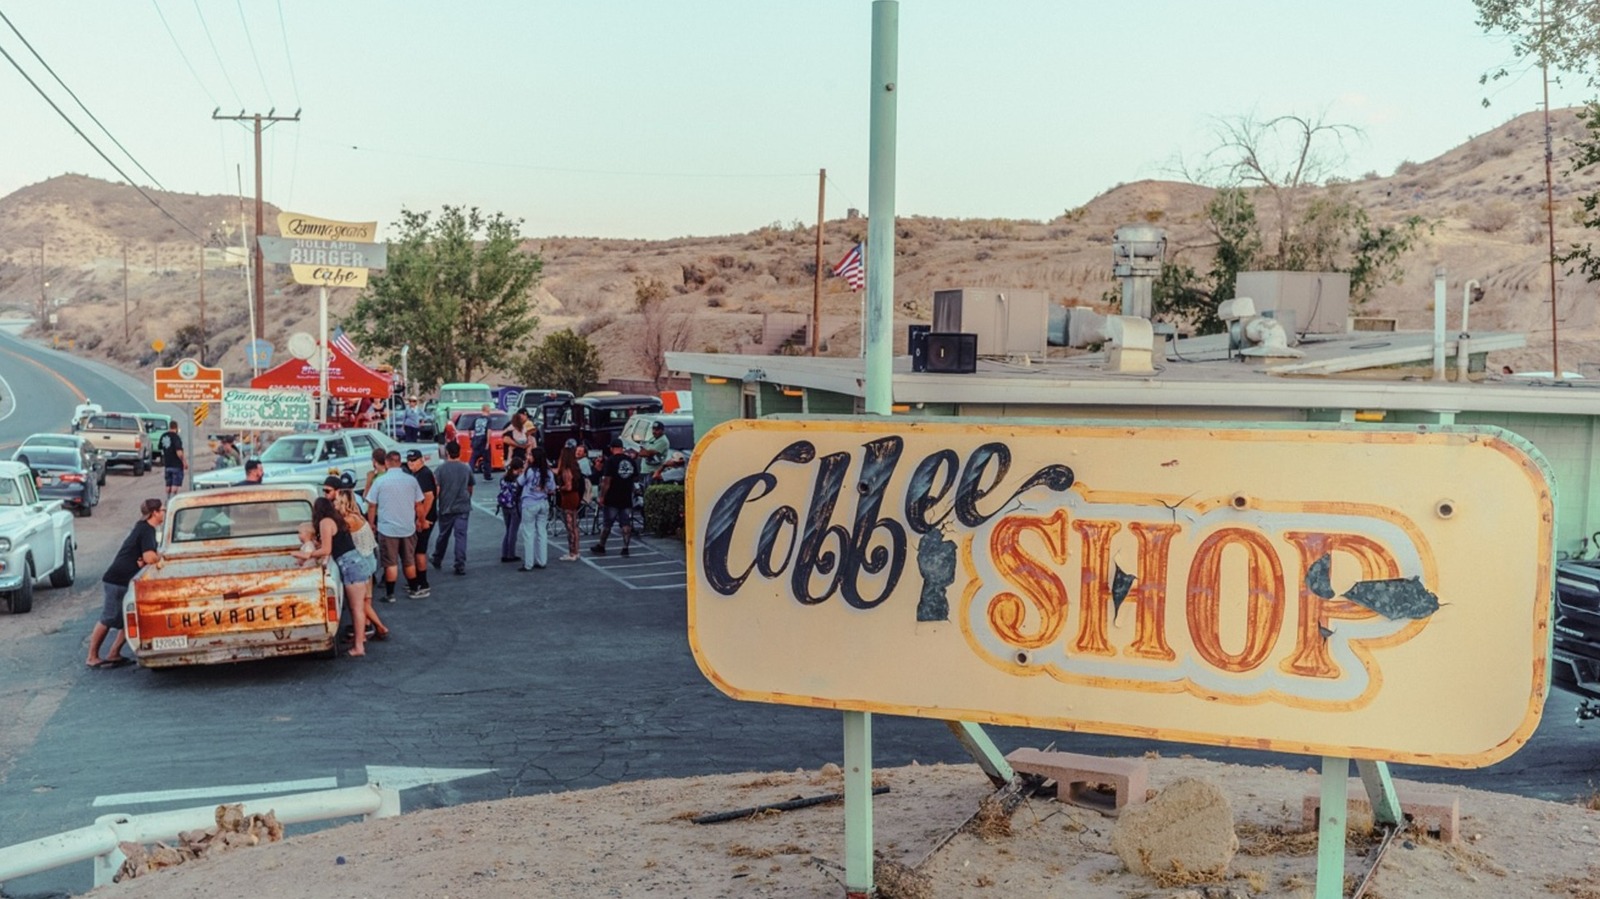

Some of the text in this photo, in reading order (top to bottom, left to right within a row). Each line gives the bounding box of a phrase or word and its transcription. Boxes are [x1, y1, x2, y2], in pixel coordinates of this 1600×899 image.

[297, 240, 356, 250] HOLLAND
[290, 248, 363, 266] BURGER
[224, 390, 307, 407] Emma Jean's
[228, 403, 257, 411] TRUCK
[258, 402, 310, 420] CAFE
[224, 418, 246, 426] Home
[260, 420, 285, 428] BRIAN
[702, 435, 1075, 609] Coffee
[987, 508, 1402, 678] SHOP
